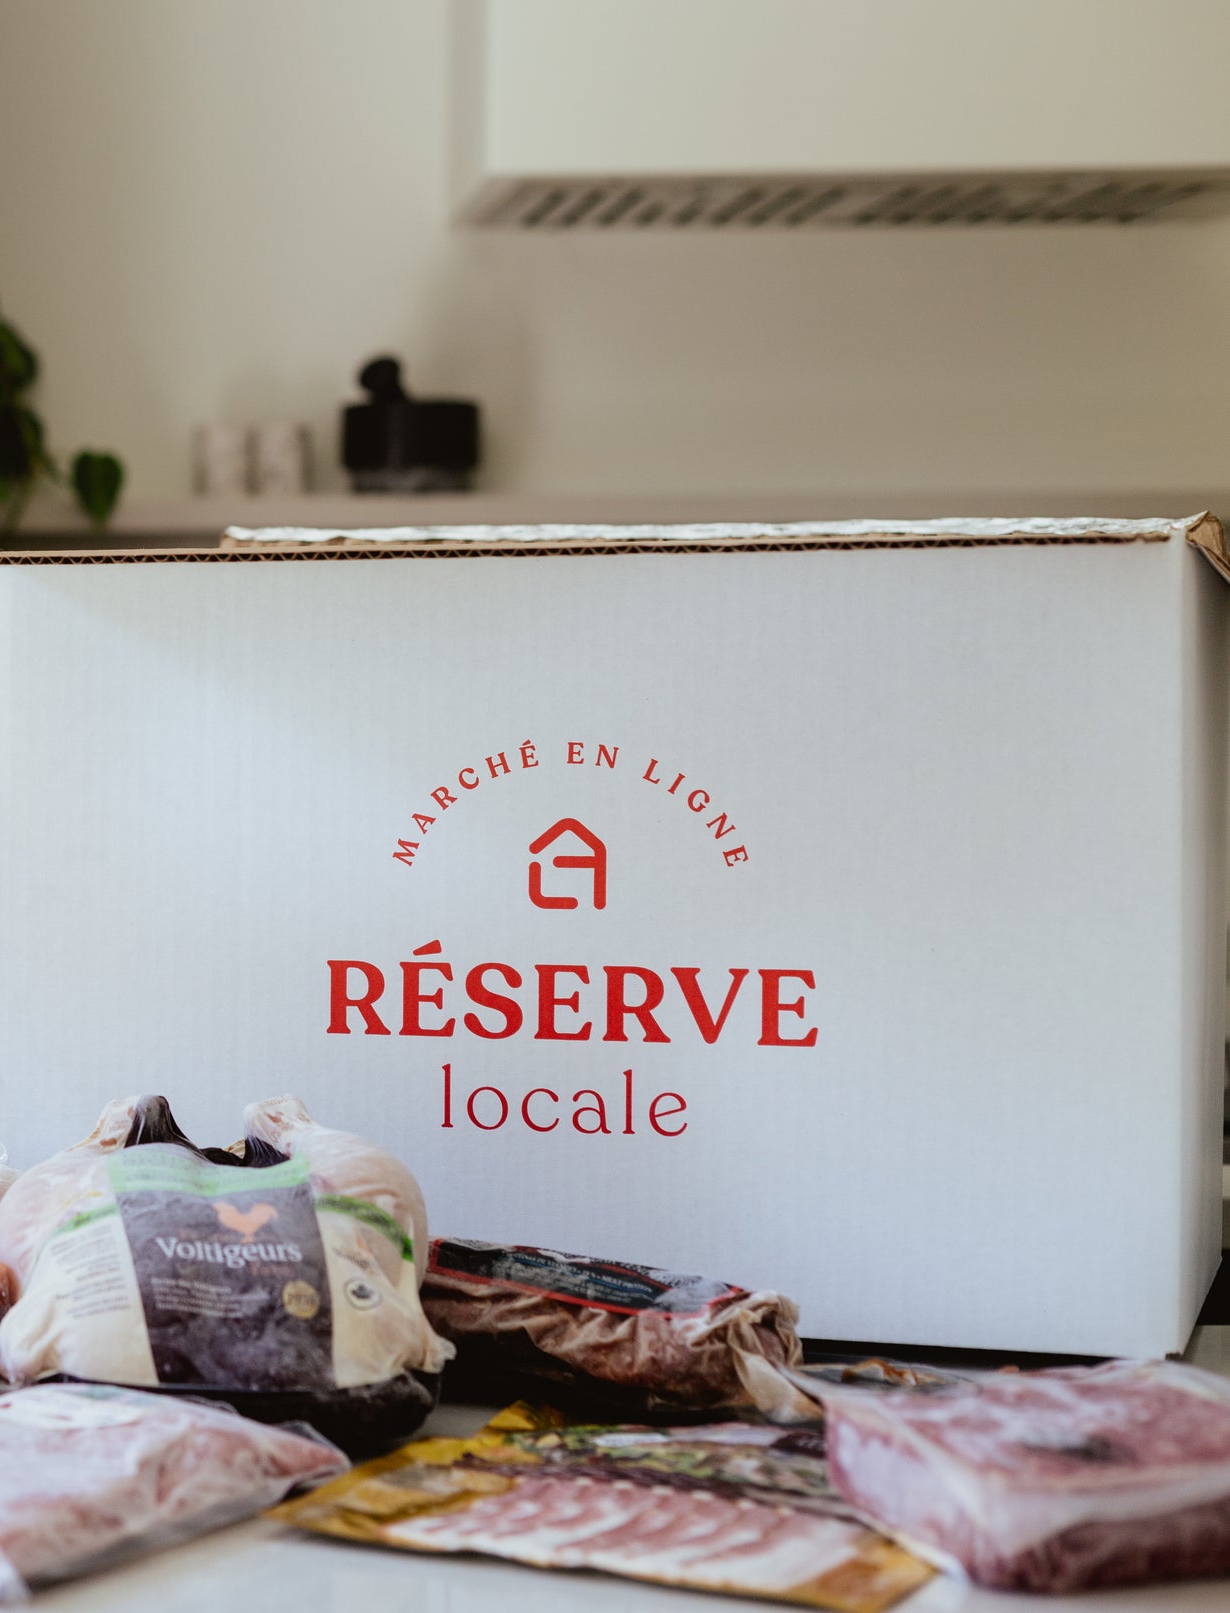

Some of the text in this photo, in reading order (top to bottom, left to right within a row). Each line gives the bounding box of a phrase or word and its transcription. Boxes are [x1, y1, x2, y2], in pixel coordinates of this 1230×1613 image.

[392, 739, 749, 868] MARCHÉ EN LIGNE
[326, 939, 819, 1048] RÉSERVE
[441, 1063, 689, 1137] locale
[155, 1236, 303, 1269] Voltigeurs
